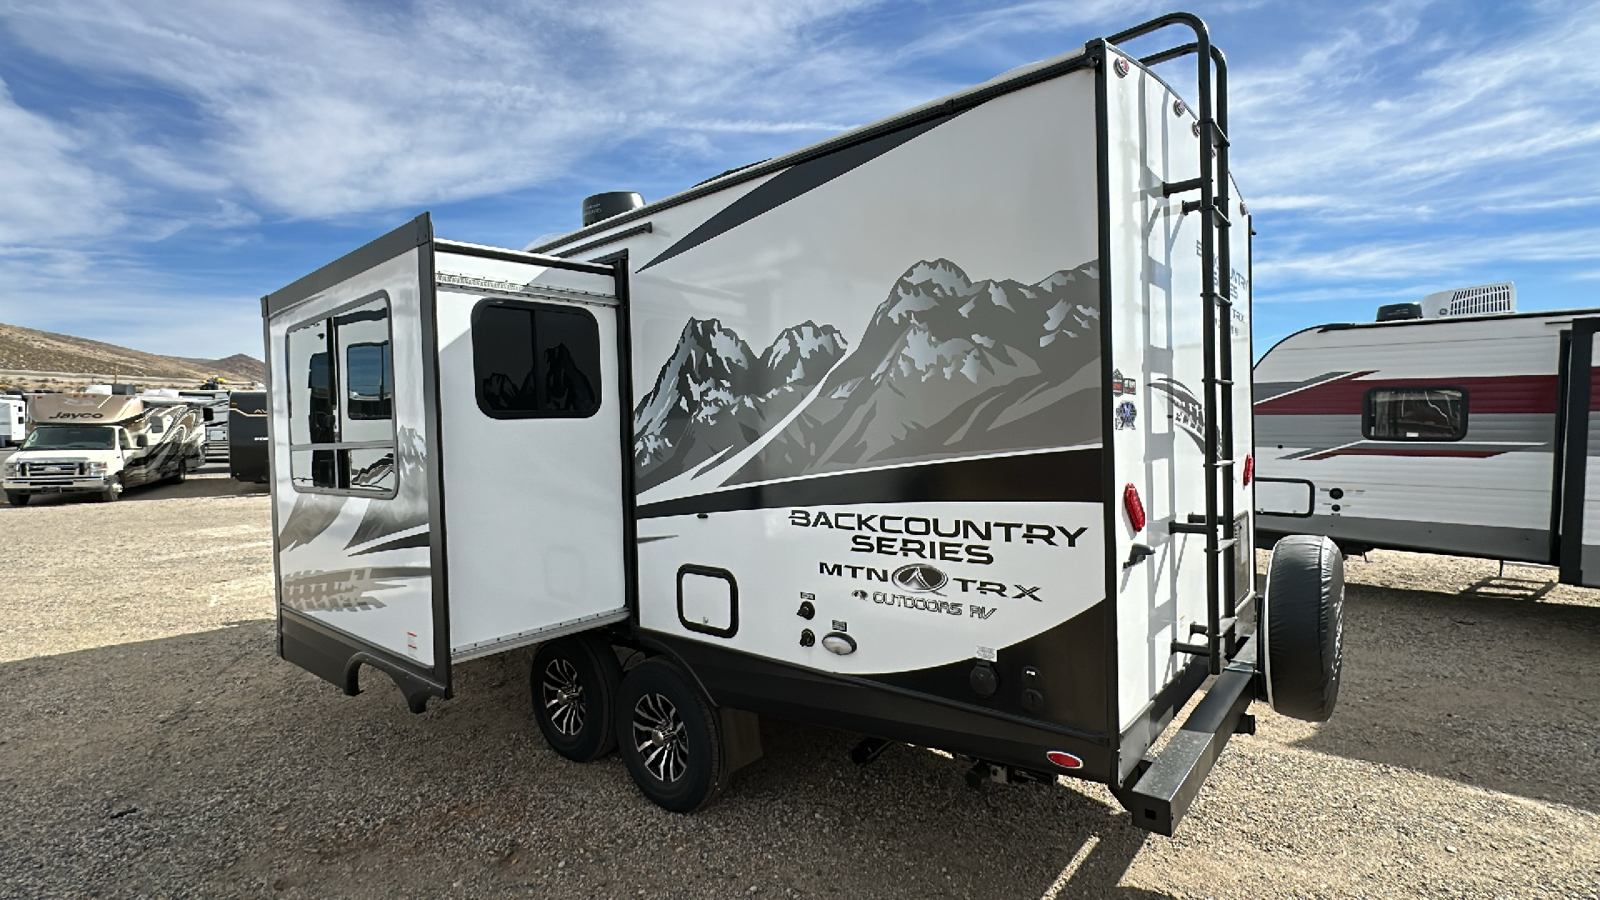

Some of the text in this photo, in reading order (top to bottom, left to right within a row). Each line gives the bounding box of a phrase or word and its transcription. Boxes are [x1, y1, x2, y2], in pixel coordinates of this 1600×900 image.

[49, 411, 103, 419] Jayco
[788, 509, 1088, 548] BACKCOUNTRY
[850, 534, 994, 565] SERIES
[819, 562, 1043, 602] MTN TRX
[873, 591, 998, 620] OUTDOORS RV
